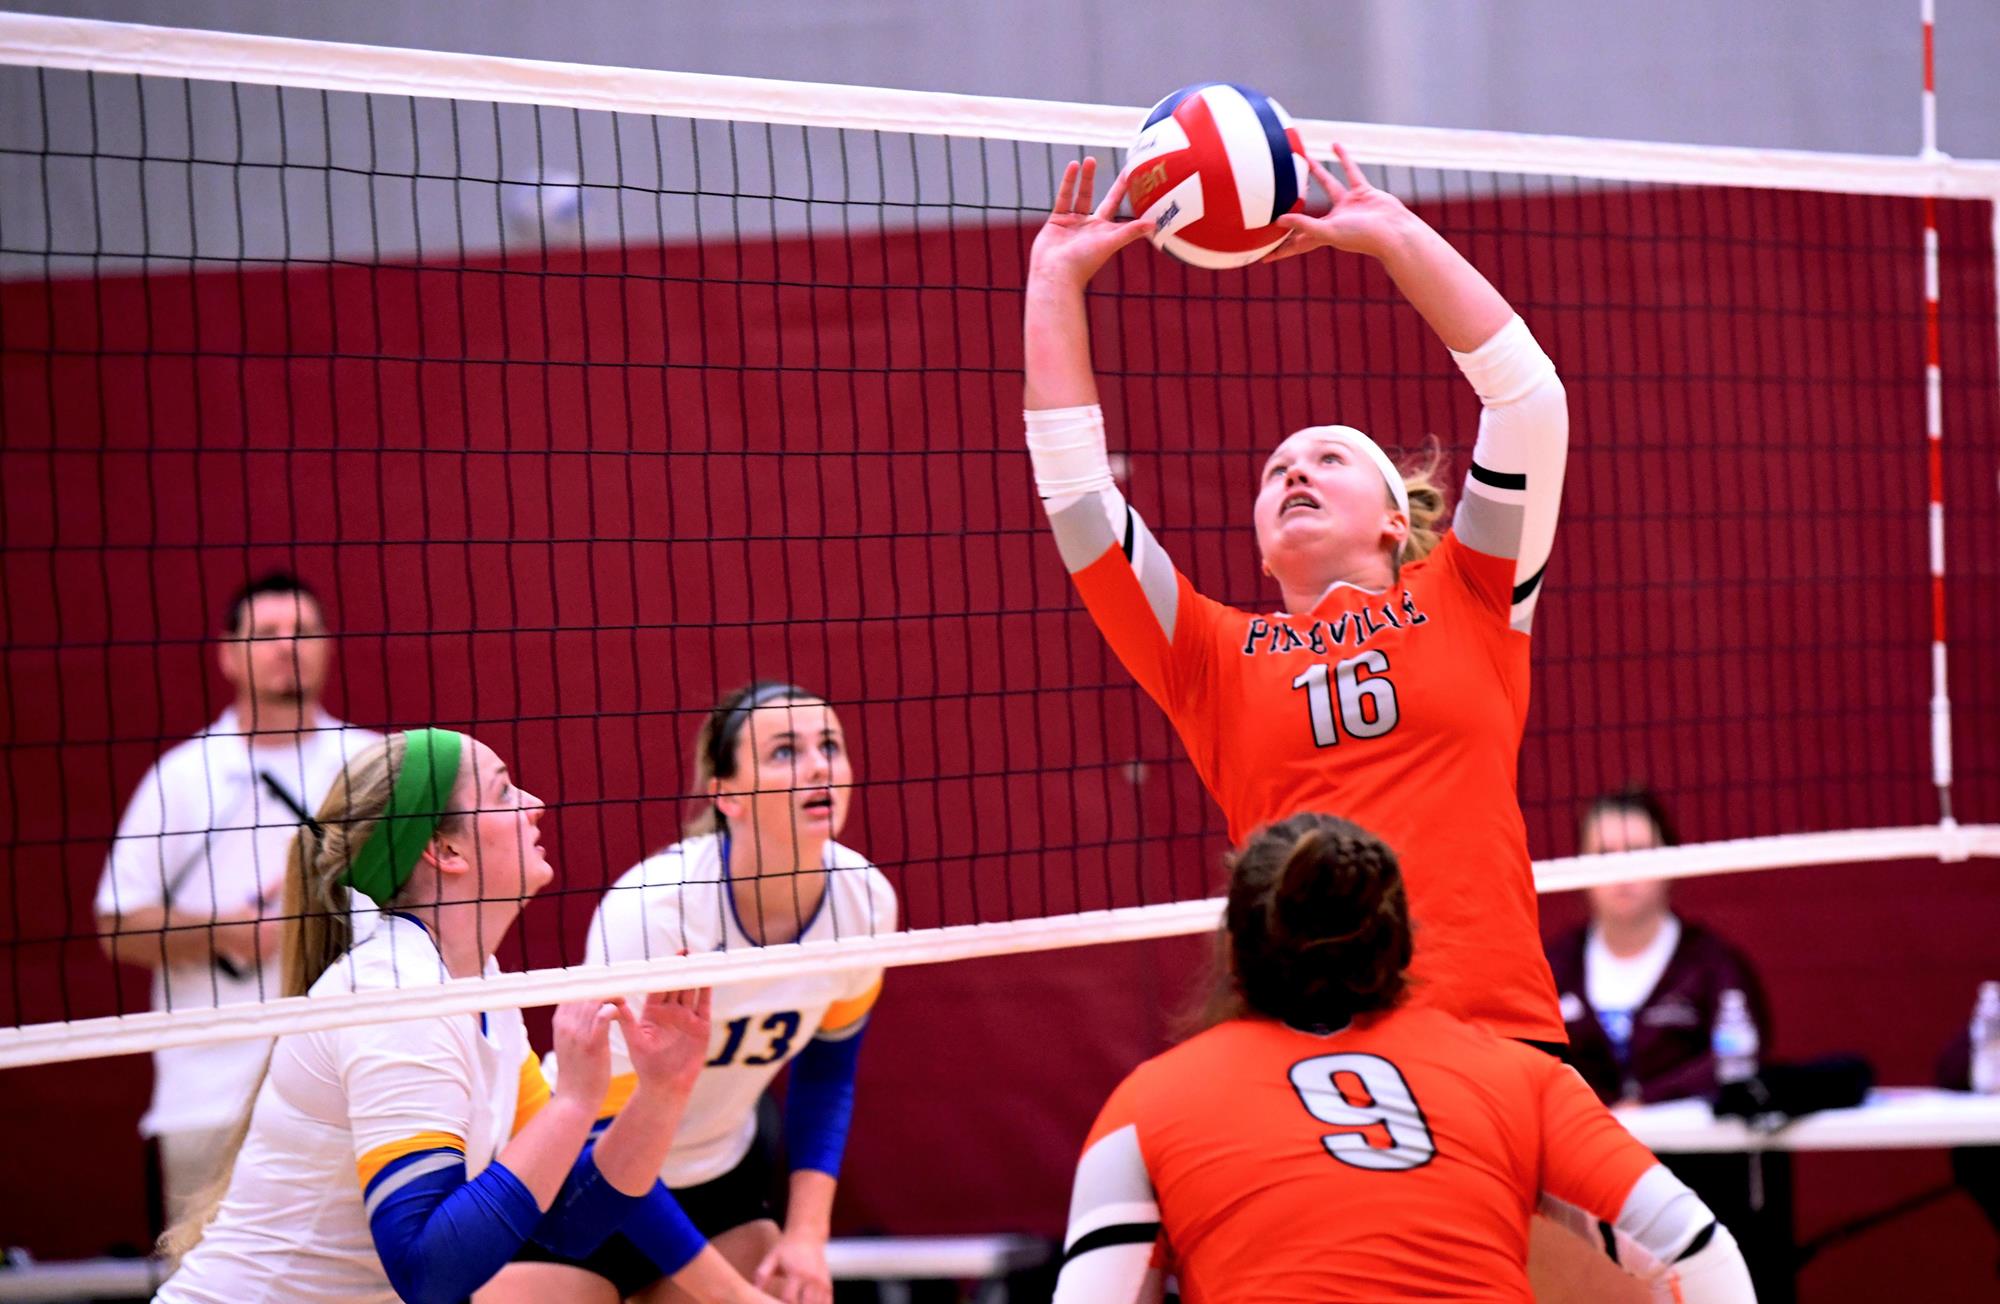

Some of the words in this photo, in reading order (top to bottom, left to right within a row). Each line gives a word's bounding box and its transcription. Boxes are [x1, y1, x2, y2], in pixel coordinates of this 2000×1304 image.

[1292, 649, 1399, 748] 16
[704, 1008, 803, 1067] 13
[1287, 1051, 1438, 1172] 9
